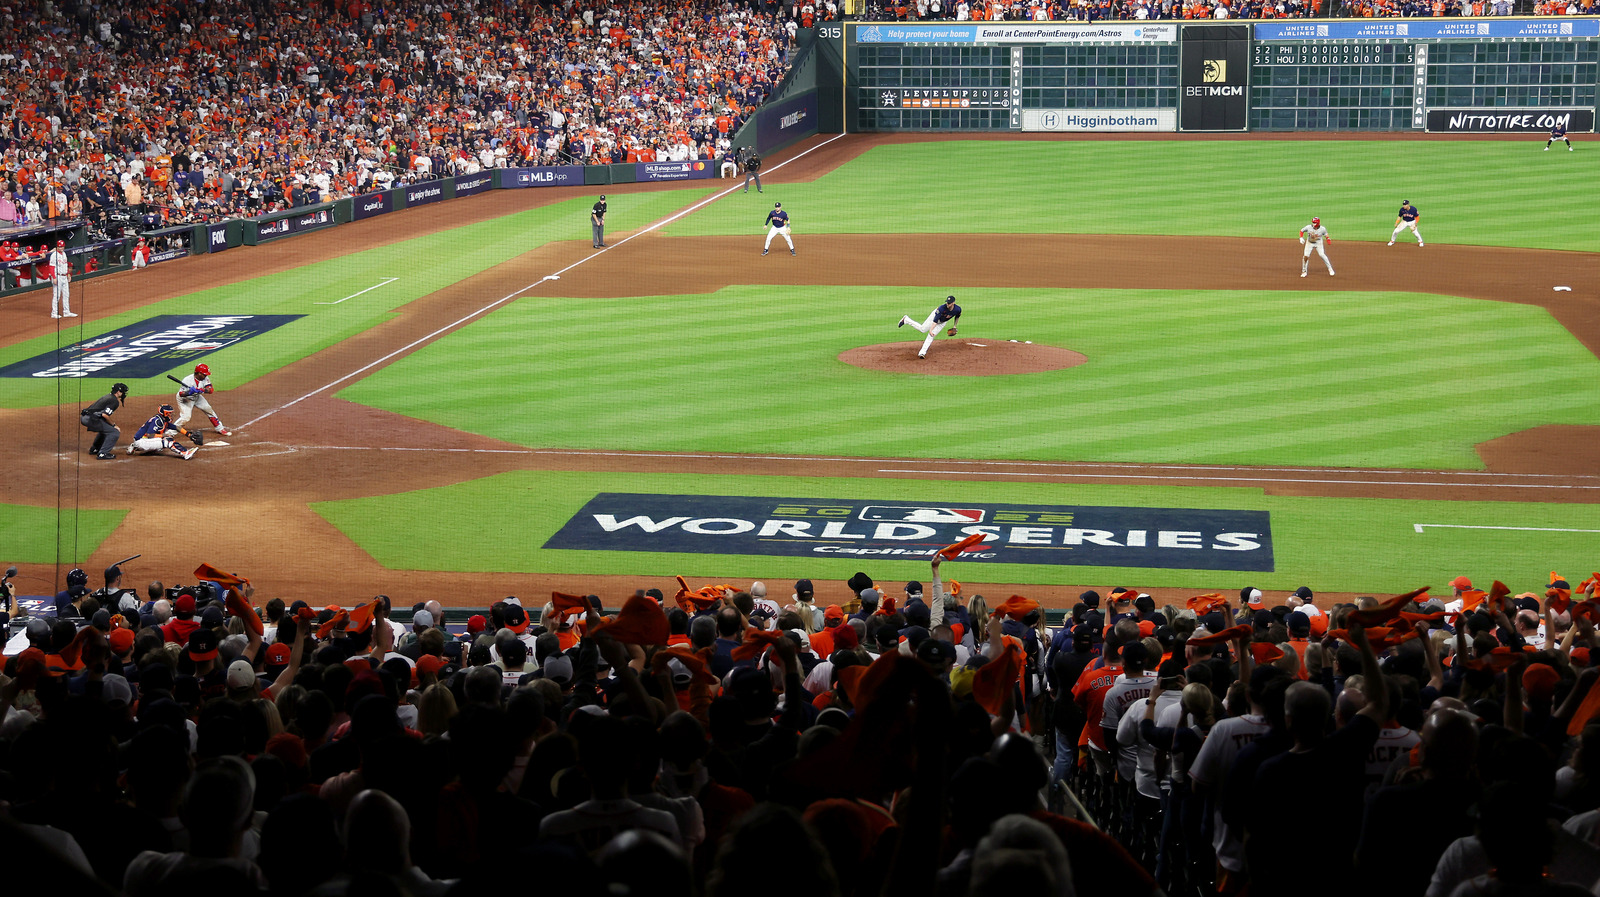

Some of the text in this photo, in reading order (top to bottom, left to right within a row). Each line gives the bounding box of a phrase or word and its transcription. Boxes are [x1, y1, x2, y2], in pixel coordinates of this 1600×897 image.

[818, 27, 841, 38] 315
[888, 30, 904, 39] Help
[906, 30, 932, 39] protect
[1014, 29, 1122, 38] CenterPointEnergy.com/Astros
[1186, 86, 1242, 96] BETMGM
[1416, 48, 1425, 124] AMERICAN
[1068, 115, 1158, 127] Higginbotham
[1449, 112, 1570, 130] NITTOTIRE.COM
[531, 172, 554, 182] MLB
[415, 191, 424, 200] enjoy
[212, 230, 226, 245] FOX
[32, 316, 254, 377] WORLD SERIES
[771, 506, 1074, 522] 20 22
[593, 514, 1262, 551] WORLD SERIES
[813, 546, 941, 556] Capital
